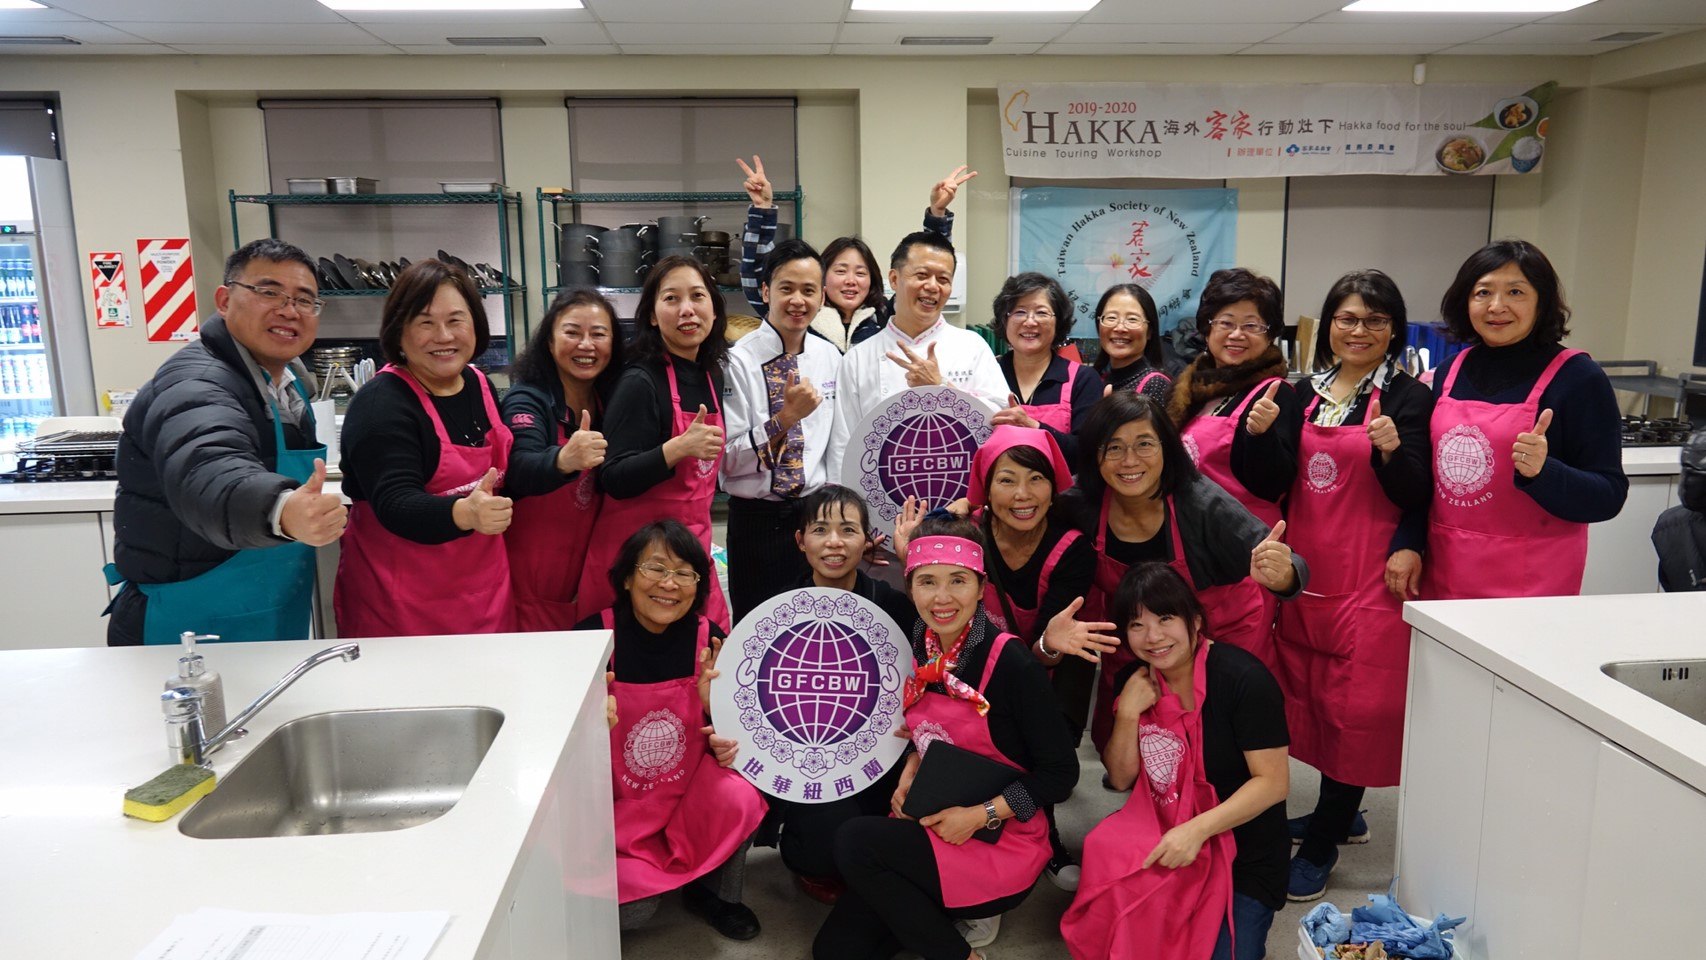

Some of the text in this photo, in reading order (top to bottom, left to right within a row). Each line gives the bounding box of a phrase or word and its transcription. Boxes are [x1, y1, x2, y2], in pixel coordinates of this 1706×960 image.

[1067, 102, 1137, 116] 2019-2020
[1022, 110, 1162, 145] HAKKA
[1338, 120, 1467, 131] Hakka food for the soul
[1006, 147, 1162, 159] Cuisine Touring Workshop
[1056, 200, 1201, 278] Taiwan Hakka Society of New Zealand
[894, 456, 964, 472] GFCBW
[1447, 454, 1478, 466] GFCBW
[1448, 491, 1493, 507] ZEALAND
[870, 527, 893, 547] NE
[777, 673, 862, 692] GFCBW
[640, 739, 673, 751] GFCBW
[1145, 751, 1178, 767] GFCBW
[621, 774, 640, 790] NEW
[742, 756, 885, 801] 世華紐西蘭
